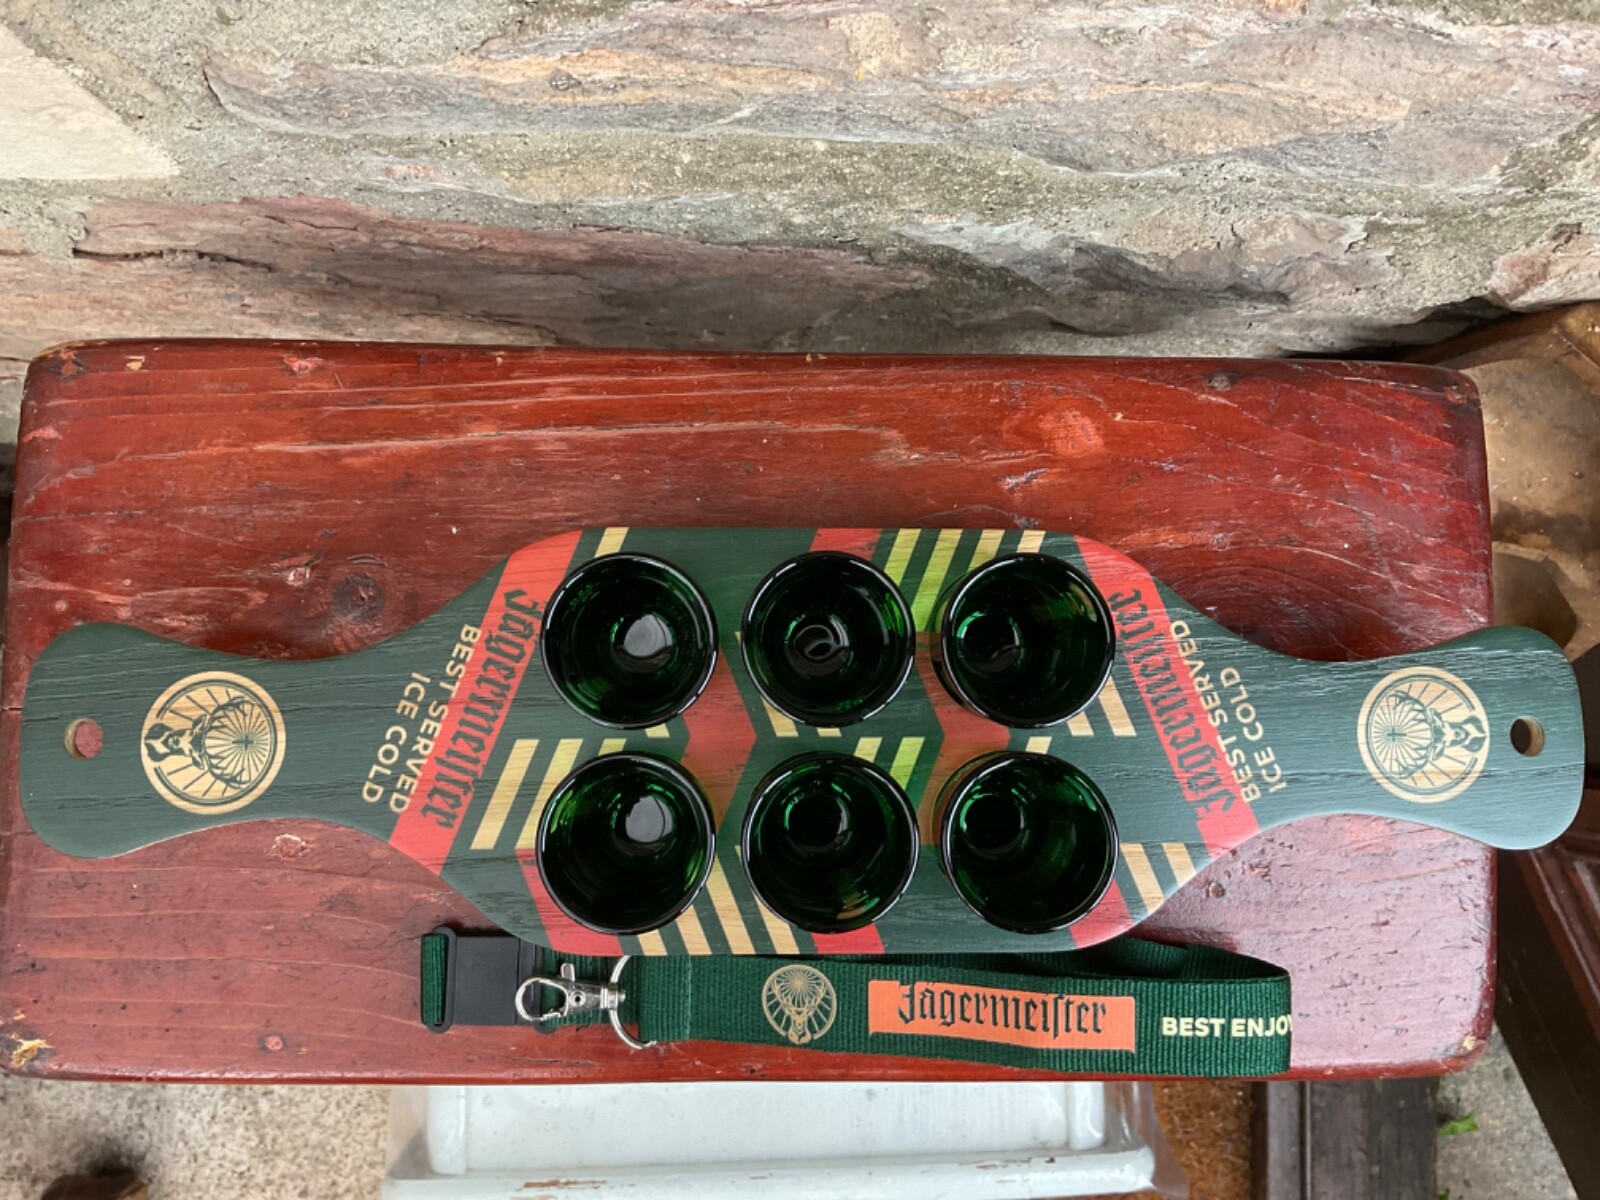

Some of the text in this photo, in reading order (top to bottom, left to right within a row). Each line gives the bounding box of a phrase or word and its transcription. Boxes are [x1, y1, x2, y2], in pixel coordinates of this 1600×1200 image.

[362, 672, 431, 803] ICE COLD
[389, 623, 482, 814] BEST SERVED
[1170, 619, 1262, 803] BEST SERVED
[1219, 667, 1287, 793] ICE COLD
[1162, 1016, 1226, 1037] BEST
